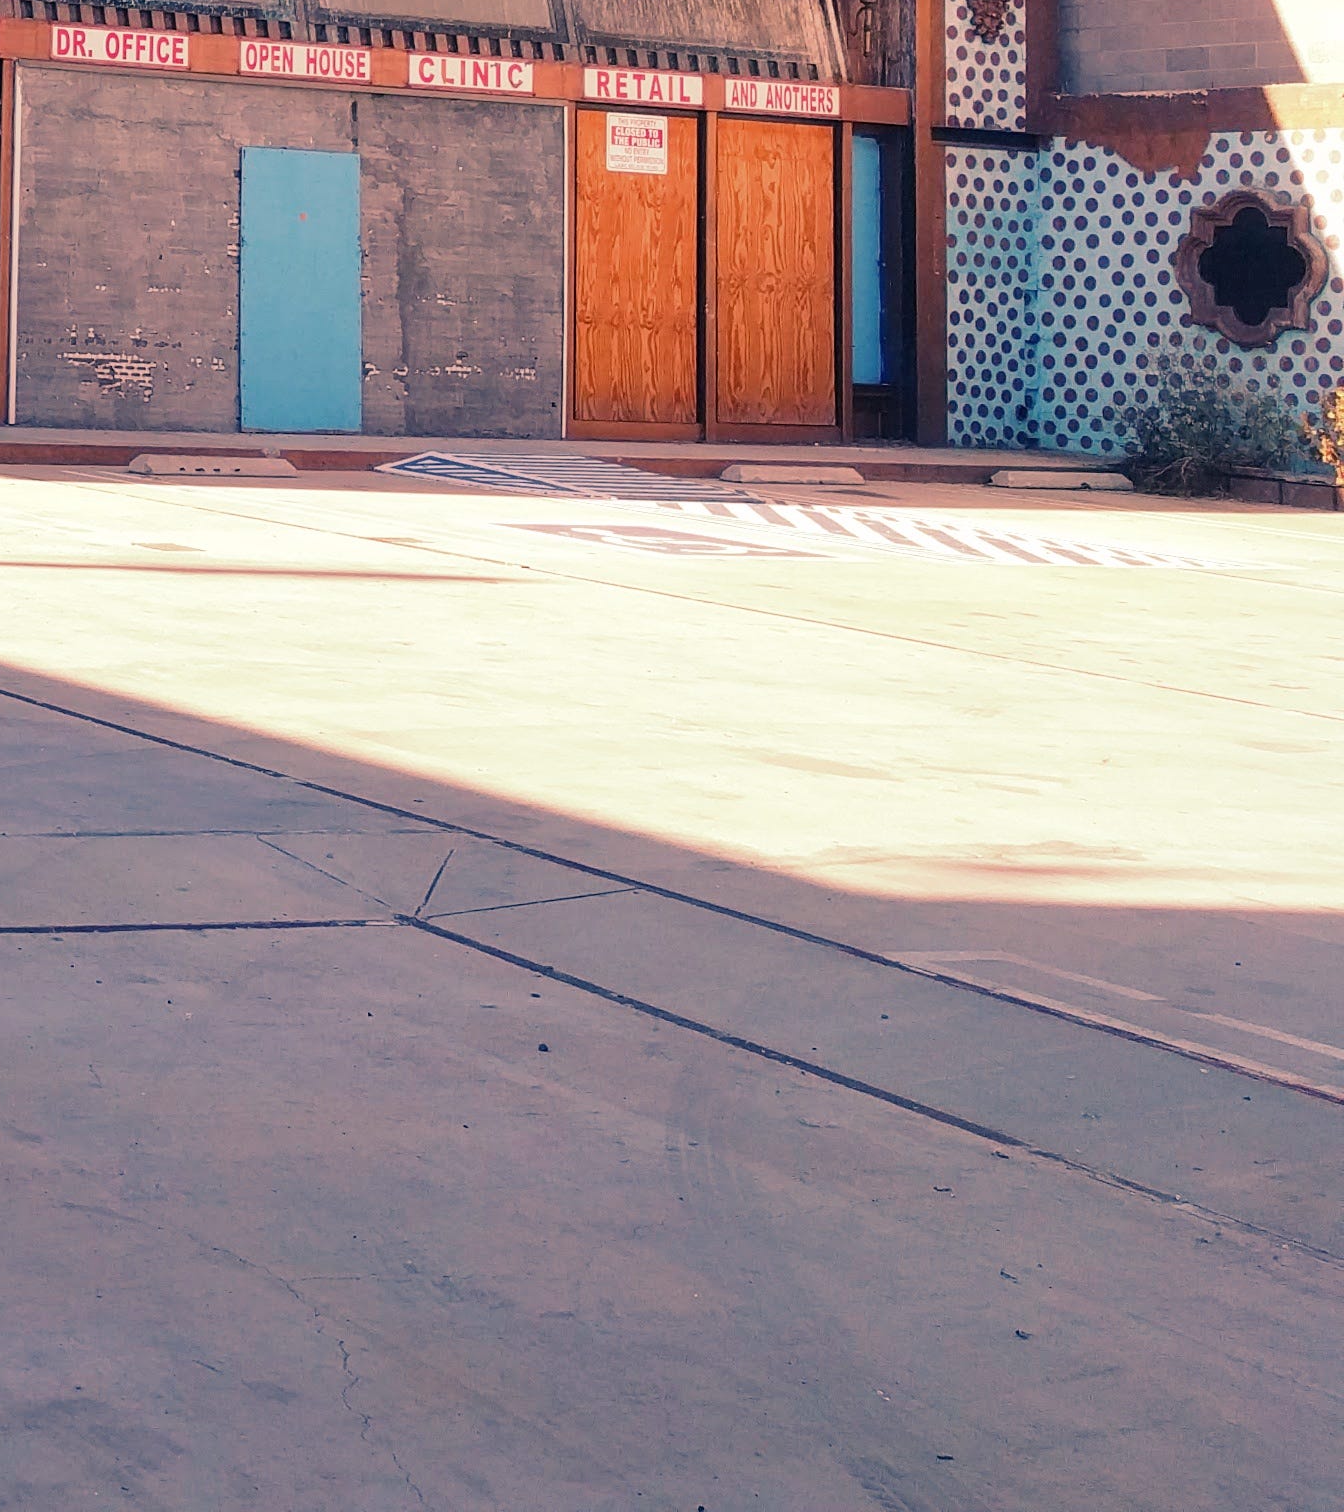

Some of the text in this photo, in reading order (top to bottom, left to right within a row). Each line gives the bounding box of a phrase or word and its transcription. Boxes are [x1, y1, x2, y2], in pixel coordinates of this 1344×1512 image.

[56, 28, 184, 64] DR. OFFICE
[245, 43, 366, 78] OPEN HOUSE
[418, 57, 523, 88] CLINIC
[597, 71, 691, 102] RETAIL
[731, 82, 833, 113] AND ANOTHERS
[614, 135, 661, 148] THE PUBLIC
[615, 126, 659, 139] CLOSED TO
